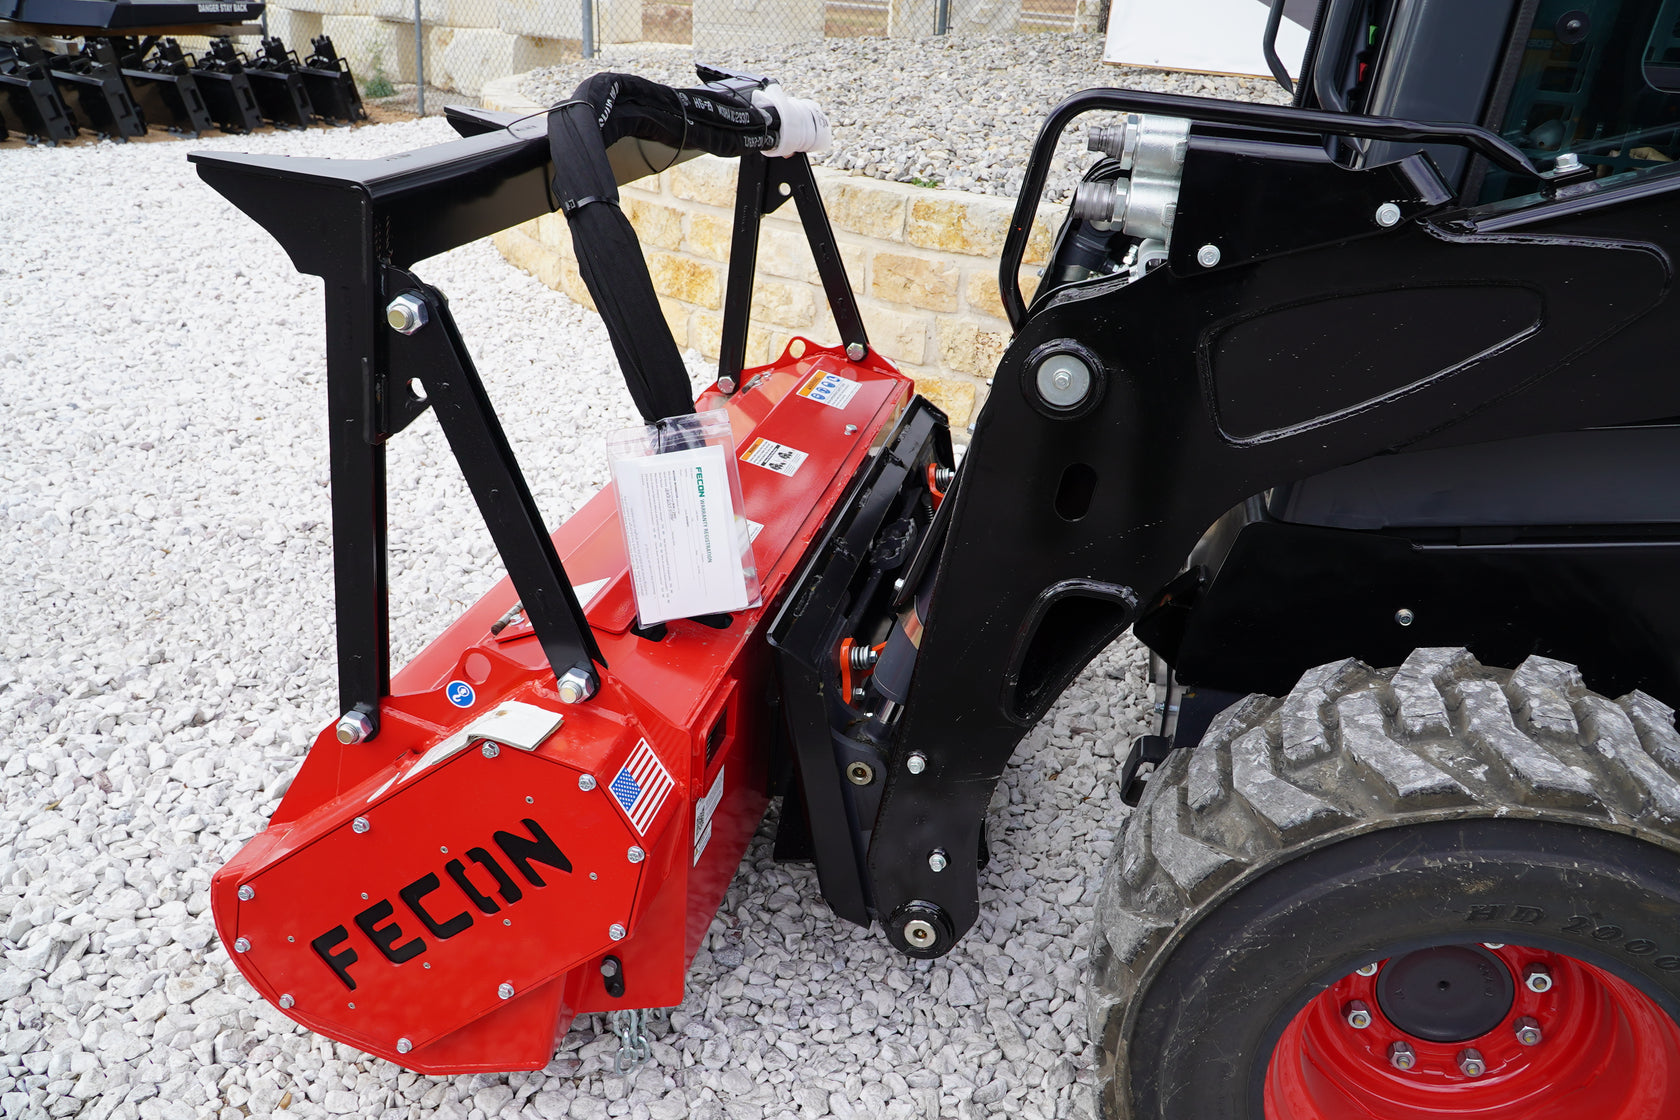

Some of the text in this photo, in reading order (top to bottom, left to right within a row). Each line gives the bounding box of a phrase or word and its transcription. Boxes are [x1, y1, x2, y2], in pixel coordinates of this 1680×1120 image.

[198, 3, 248, 13] DANGER STAY BACK
[695, 466, 713, 563] FECON WARRANTY REGISTRATION
[311, 817, 573, 992] FECON
